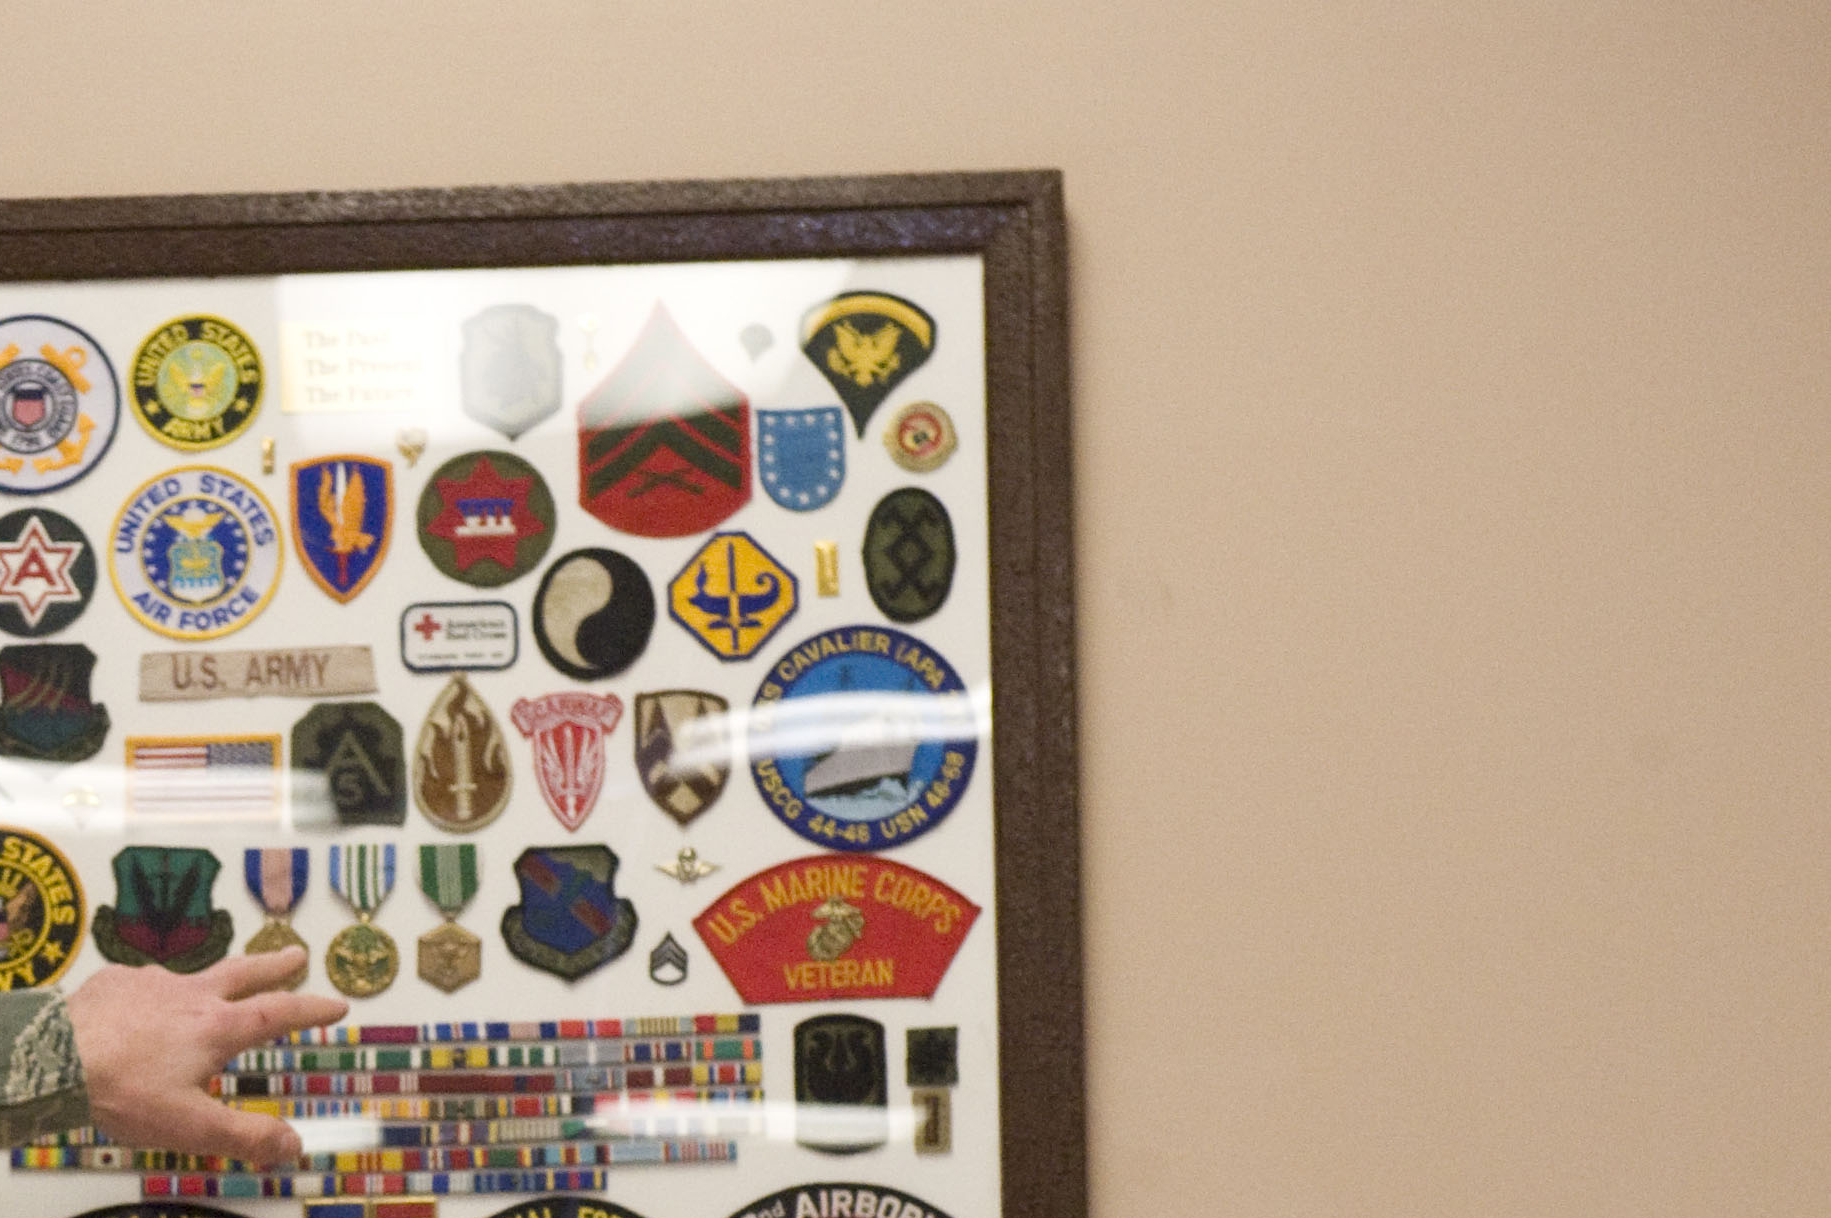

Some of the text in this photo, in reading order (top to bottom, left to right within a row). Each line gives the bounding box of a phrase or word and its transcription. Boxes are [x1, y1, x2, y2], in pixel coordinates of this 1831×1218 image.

[135, 322, 259, 385] UNITED STATES
[163, 417, 225, 441] ARMY
[117, 474, 275, 554] UNITED STATES
[133, 587, 260, 630] AIR FORCE
[170, 655, 330, 690] U.S. ARMY
[778, 631, 891, 681] CAVALIER
[880, 805, 929, 840] USN
[2, 836, 76, 925] STATES
[707, 864, 962, 945] U.S. MARINE CORPS
[783, 959, 894, 990] VETERAN
